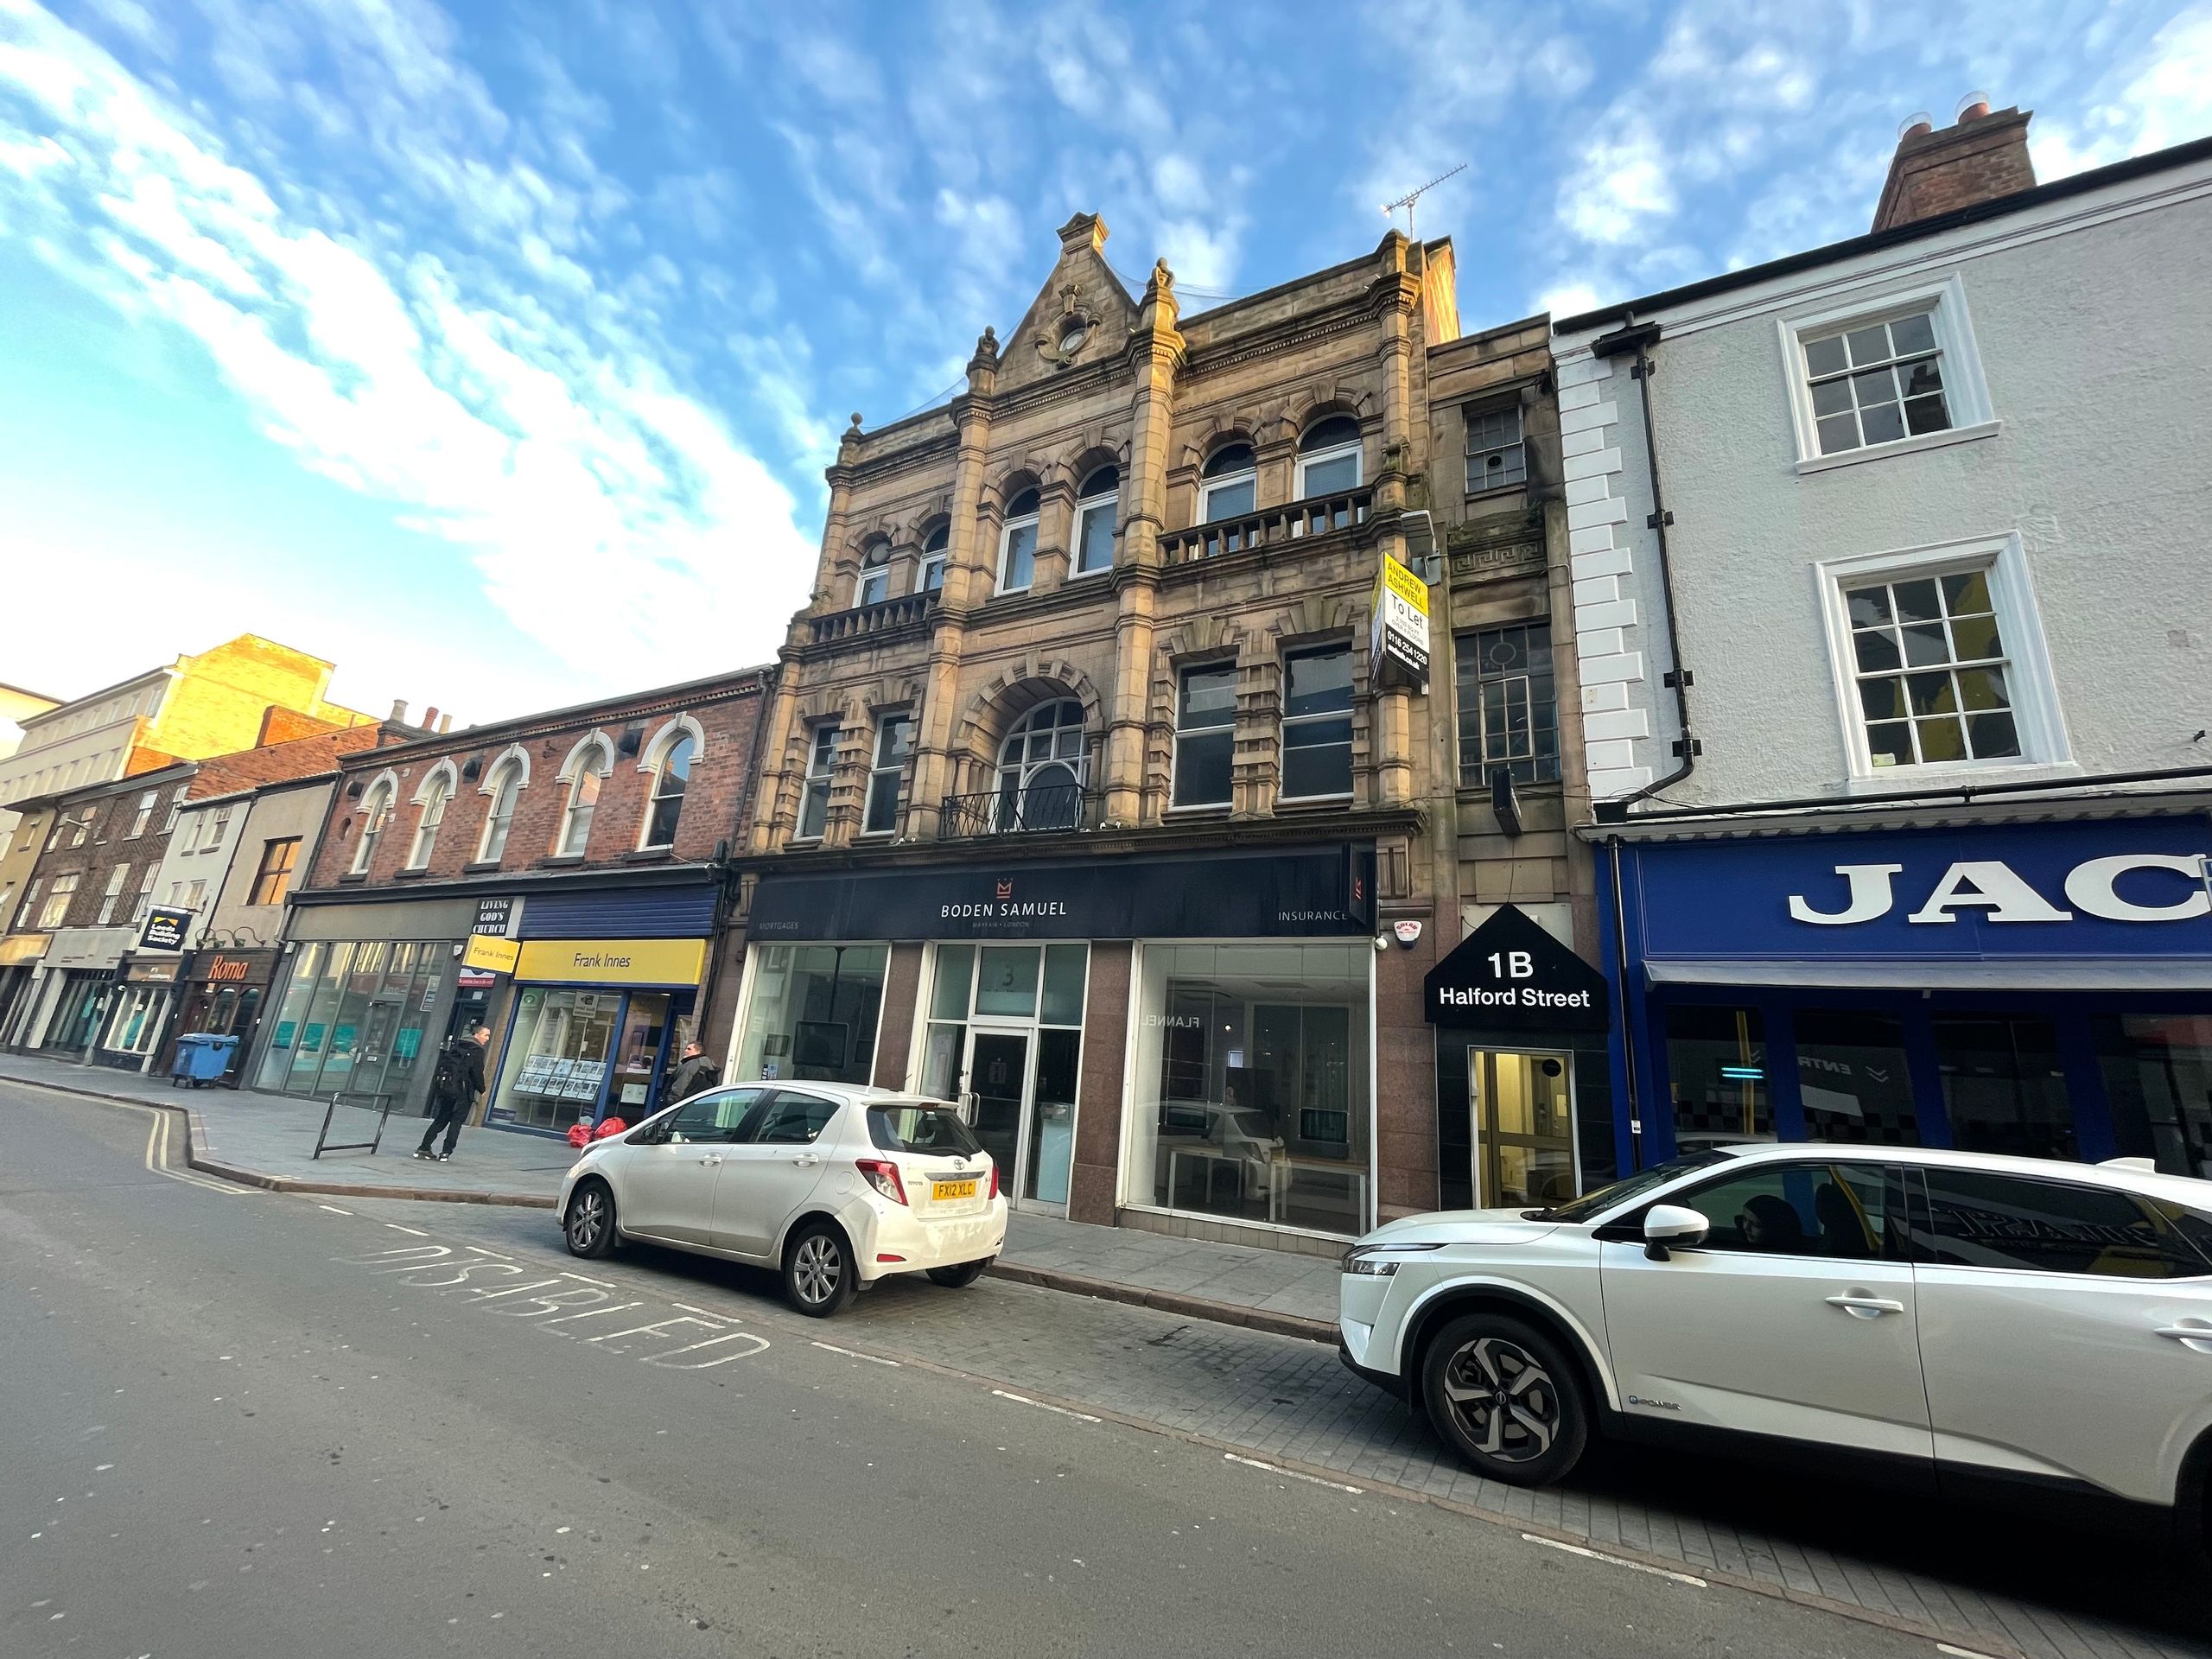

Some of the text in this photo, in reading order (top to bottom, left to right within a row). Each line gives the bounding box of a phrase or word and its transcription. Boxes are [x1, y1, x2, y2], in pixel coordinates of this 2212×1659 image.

[1388, 562, 1421, 594] ANDREW
[1388, 575, 1424, 609] ASHWELL
[1391, 594, 1423, 630] To Let
[1387, 631, 1427, 665] 0116 254 1220
[480, 899, 509, 910] LIVING
[941, 901, 1067, 918] BODEN SAMUEL
[480, 912, 505, 922] GOD'S
[151, 923, 175, 933] Leeds
[473, 924, 506, 934] CHURCH
[759, 921, 799, 931] MORTGAGES
[147, 935, 178, 945] Society
[149, 929, 181, 941] Building
[474, 947, 514, 961] Frank Innes
[573, 952, 631, 968] Frank Innes
[207, 955, 249, 981] Roma
[1488, 951, 1534, 978] 1B
[1440, 988, 1591, 1007] Halford Street
[938, 1183, 973, 1198] FX12 XLC
[337, 1244, 772, 1370] DISABLED
